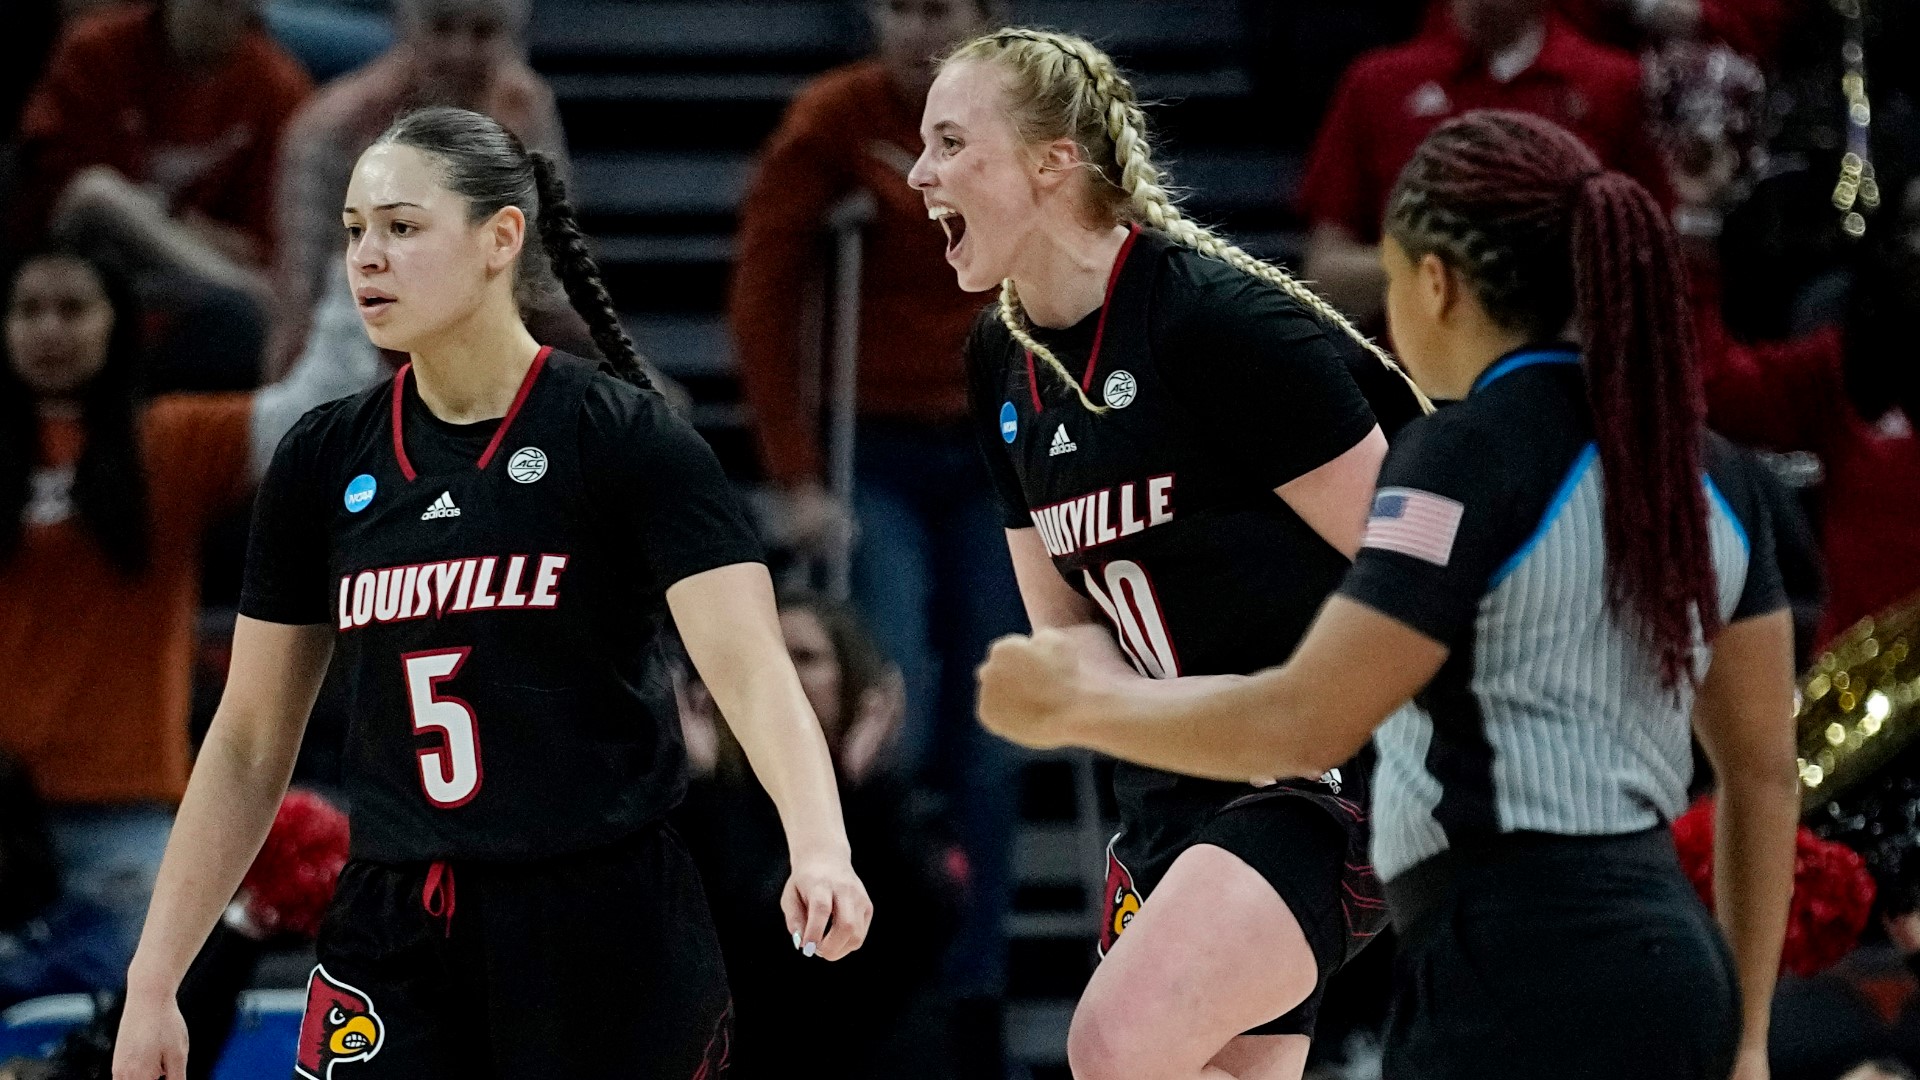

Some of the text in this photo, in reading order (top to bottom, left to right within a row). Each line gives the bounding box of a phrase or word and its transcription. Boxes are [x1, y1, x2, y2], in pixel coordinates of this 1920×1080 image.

[1110, 381, 1133, 393] ACC
[1049, 442, 1077, 456] adidas
[421, 507, 461, 521] adidas
[338, 553, 570, 632] LOUISVILLE
[400, 646, 483, 809] 5
